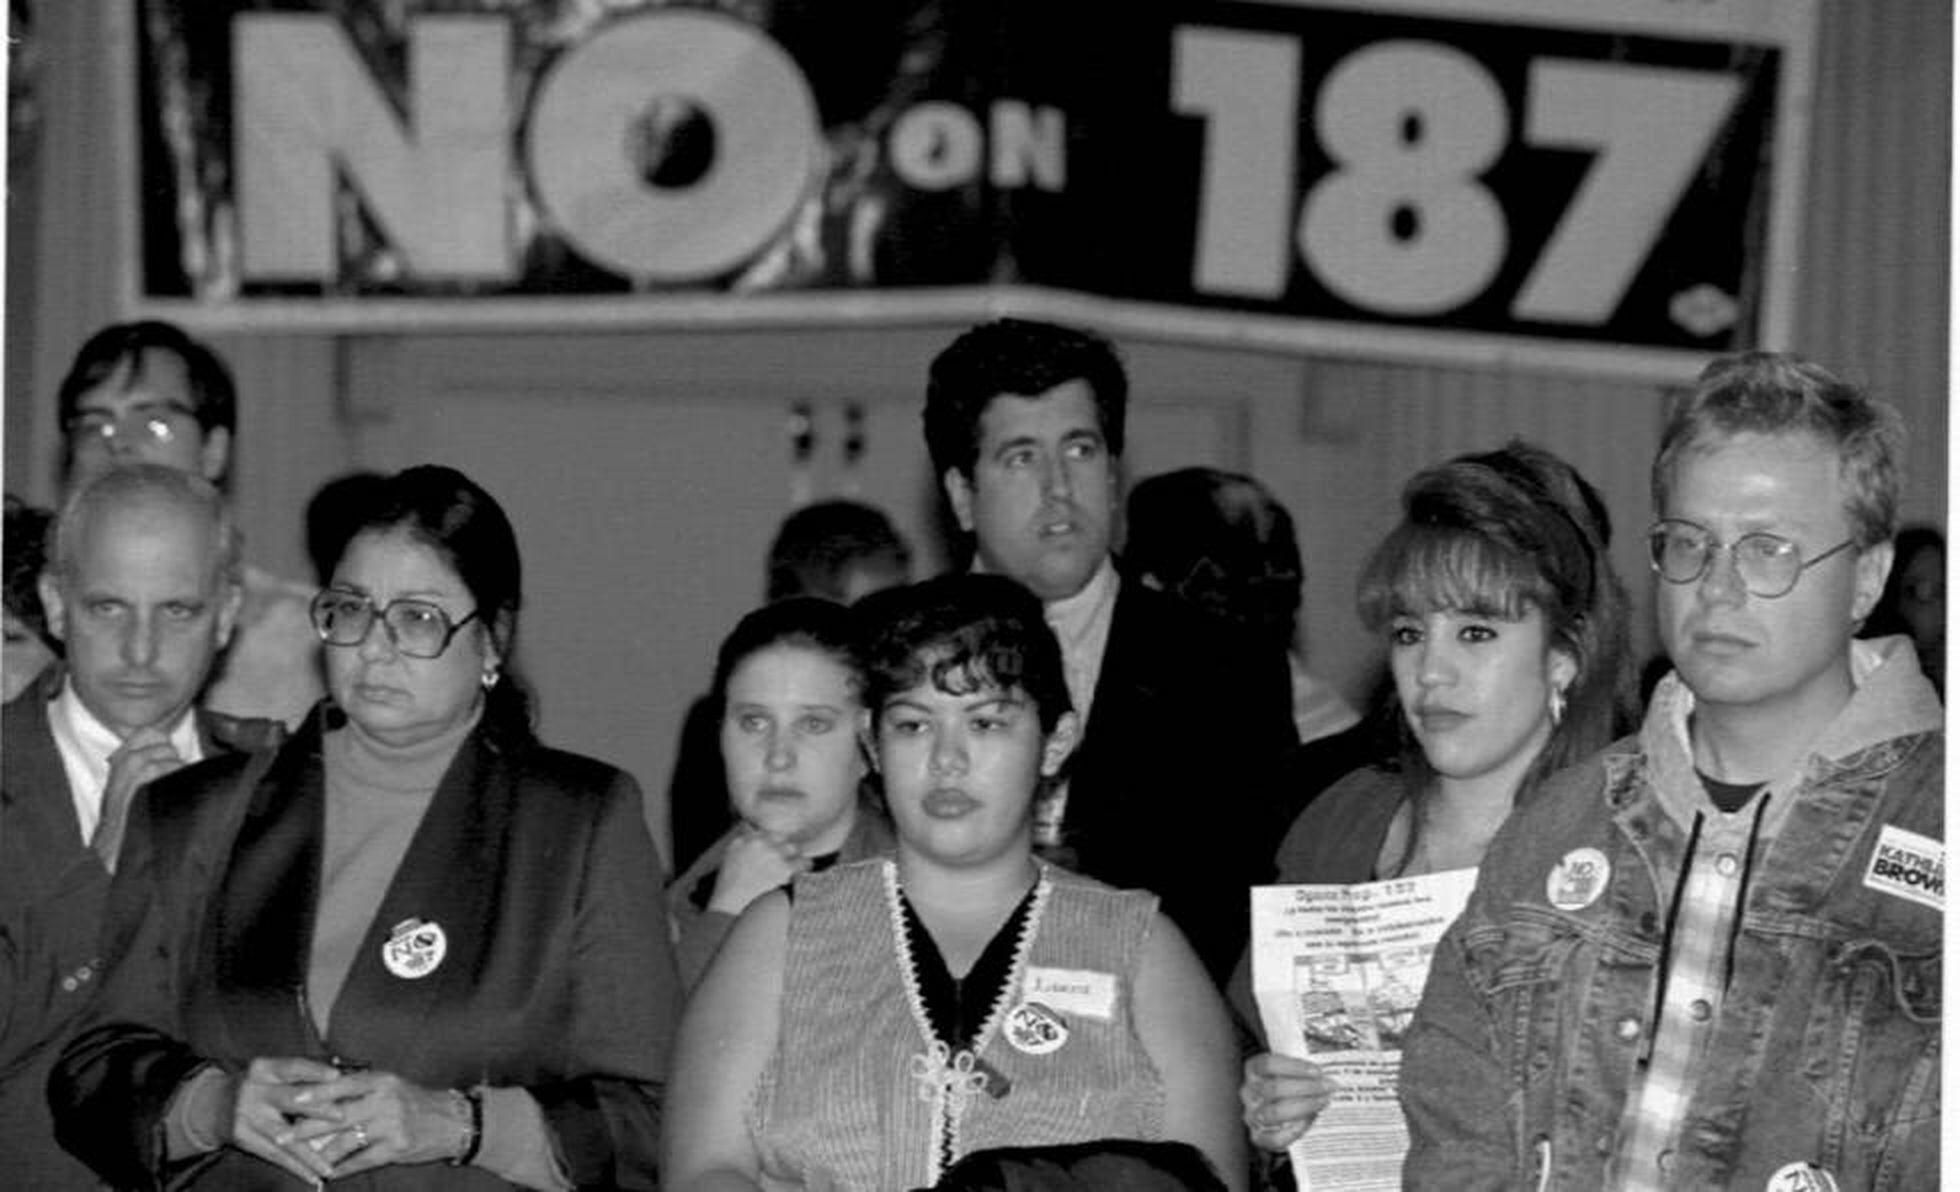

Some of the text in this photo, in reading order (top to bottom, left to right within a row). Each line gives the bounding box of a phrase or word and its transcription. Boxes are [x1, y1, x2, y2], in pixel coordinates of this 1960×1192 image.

[231, 12, 1744, 326] NO ON 187
